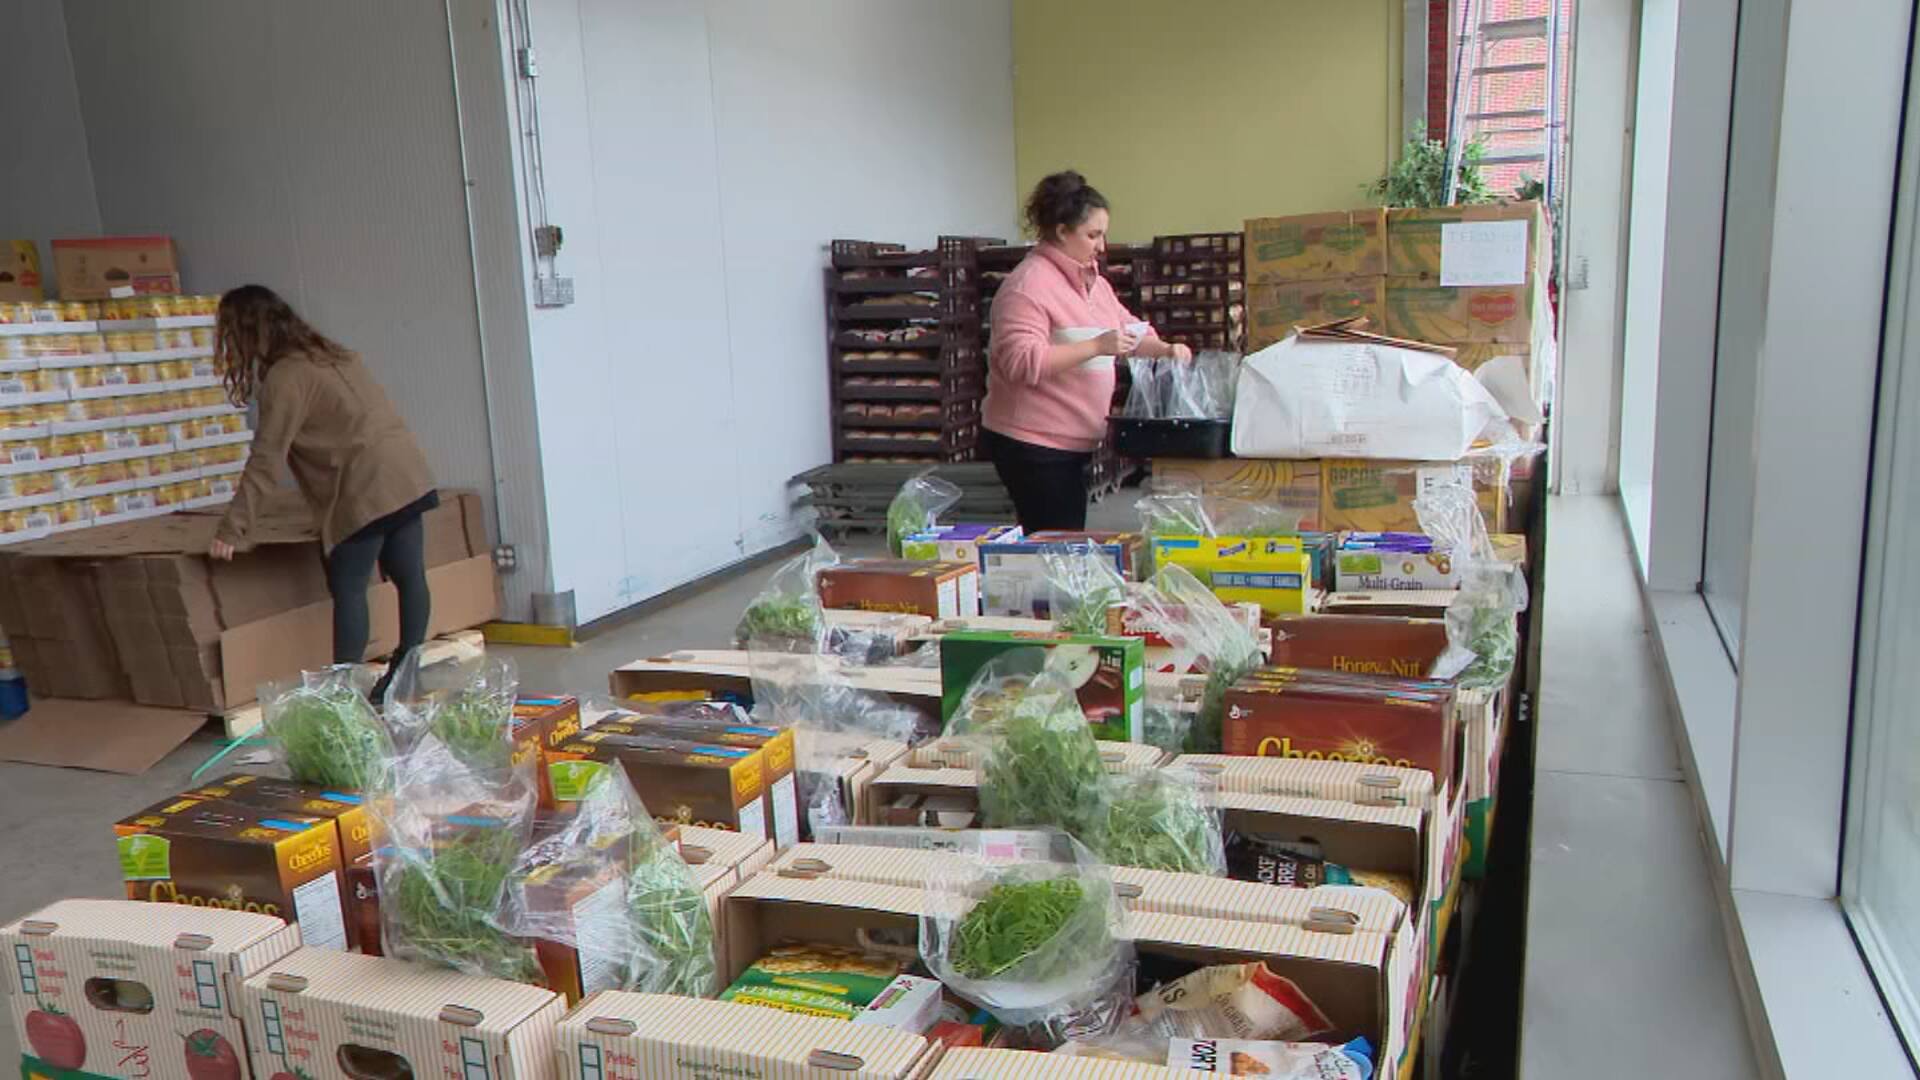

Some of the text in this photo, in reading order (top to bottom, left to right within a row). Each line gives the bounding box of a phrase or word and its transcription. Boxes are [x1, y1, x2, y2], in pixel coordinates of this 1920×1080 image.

[1358, 575, 1423, 591] Multi-Grain
[1332, 655, 1421, 677] Honey Nut
